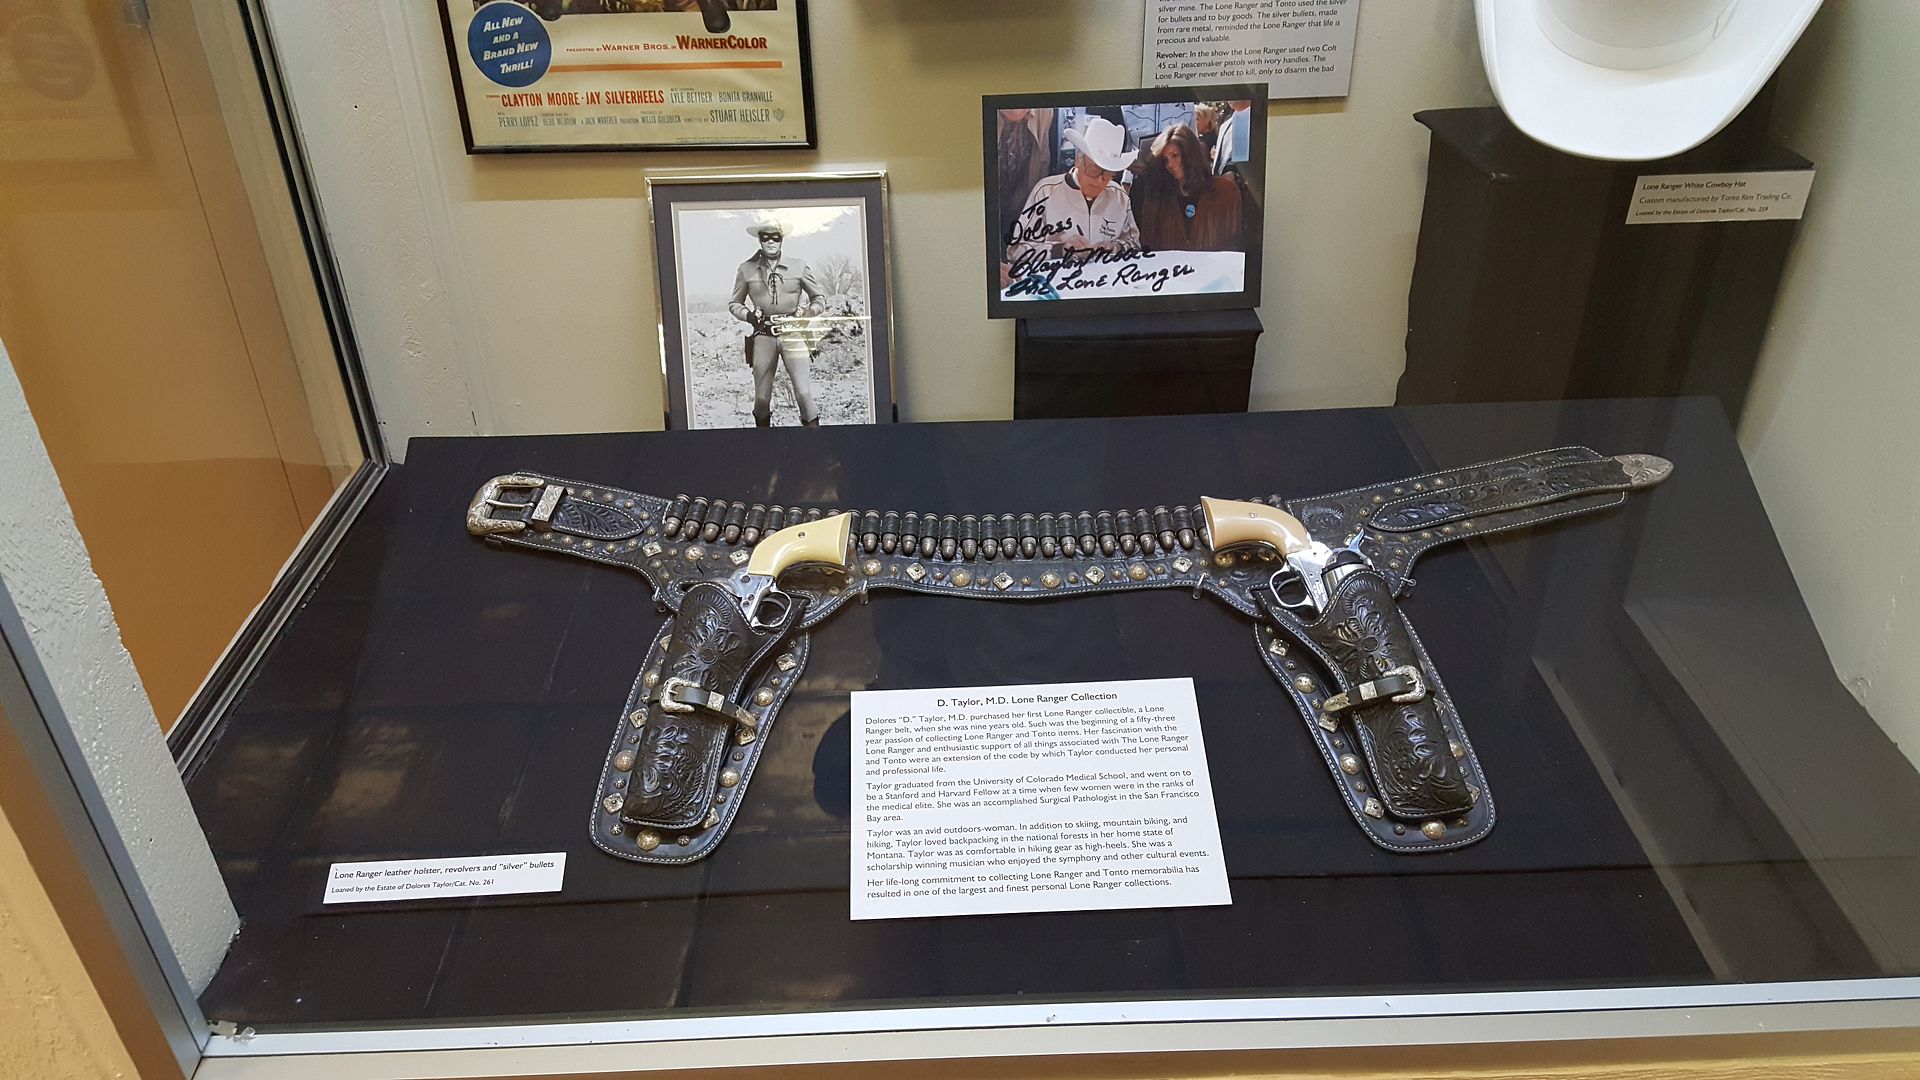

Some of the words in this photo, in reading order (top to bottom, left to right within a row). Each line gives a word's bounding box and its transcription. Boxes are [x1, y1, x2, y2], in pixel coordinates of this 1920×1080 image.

[483, 21, 500, 32] ALL
[502, 16, 523, 28] NEW
[1157, 26, 1175, 34] from
[1215, 22, 1249, 31] reminded
[1250, 22, 1262, 30] the
[1263, 21, 1281, 29] Lone
[1282, 20, 1307, 31] Ranger
[1308, 19, 1322, 27] that
[1322, 18, 1334, 26] life
[493, 34, 510, 44] AND
[676, 34, 768, 50] WARNERCOLOR
[1156, 36, 1186, 47] precious
[1187, 35, 1201, 43] and
[483, 48, 515, 60] BRAND
[516, 42, 539, 54] NEW
[1156, 50, 1188, 59] Revolver:
[1198, 49, 1210, 57] the
[1211, 48, 1230, 57] show
[1231, 48, 1243, 56] the
[1244, 47, 1262, 55] Lone
[1263, 46, 1287, 57] Ranger
[1288, 45, 1306, 53] used
[1306, 44, 1321, 52] two
[1322, 43, 1337, 51] Colt
[500, 59, 534, 74] THRILL!
[501, 92, 543, 107] CLAYTON
[547, 92, 580, 106] MOORE
[586, 91, 601, 105] JAY
[604, 90, 665, 105] SILVERHEELS
[670, 92, 684, 103] LYLE
[686, 91, 713, 103] BETTGER
[718, 91, 740, 102] BONITA
[742, 91, 773, 102] GRANVILLE
[499, 117, 518, 128] PERRY
[520, 116, 538, 127] LOPEZ
[710, 109, 737, 123] STUART
[740, 108, 770, 122] HEISLER
[1660, 182, 1683, 191] Ranger
[1706, 181, 1734, 189] Cowboy
[1022, 196, 1050, 218] To
[937, 698, 948, 707] D.
[950, 696, 983, 708] Taylor,
[986, 696, 1009, 705] M.D.
[1011, 695, 1035, 704] Lone
[1036, 693, 1069, 705] Ranger
[1070, 692, 1118, 702] Collection
[866, 746, 886, 755] Lone
[888, 745, 915, 756] Ranger
[917, 744, 932, 753] and
[933, 742, 979, 752] enthusiastic
[981, 741, 1012, 752] support
[1013, 740, 1022, 749] of
[1024, 740, 1033, 748] all
[1034, 739, 1058, 750] things
[1059, 737, 1100, 747] associated
[1101, 736, 1120, 745] with
[1120, 736, 1138, 744] The
[1139, 735, 1160, 744] Lone
[1161, 734, 1189, 745] Ranger
[866, 781, 892, 792] Taylor
[894, 779, 934, 791] graduated
[936, 778, 956, 787] from
[957, 777, 971, 786] the
[973, 776, 1014, 788] University
[1015, 775, 1024, 784] of
[1025, 774, 1064, 783] Colorado
[1066, 772, 1097, 781] Medical
[1098, 771, 1129, 782] School,
[1130, 770, 1145, 779] and
[1146, 769, 1168, 778] went
[1182, 768, 1192, 776] to
[866, 803, 880, 811] the
[881, 801, 913, 810] medical
[914, 800, 935, 809] elite.
[937, 800, 952, 808] She
[983, 796, 1038, 808] accomplished
[1039, 794, 1071, 806] Surgical
[1072, 792, 1118, 805] Pathologist
[1119, 792, 1127, 800] in
[1128, 791, 1143, 800] the
[1144, 791, 1159, 799] San
[1160, 789, 1200, 799] Francisco
[867, 861, 913, 873] scholarship
[915, 859, 947, 871] winning
[949, 858, 985, 867] musician
[987, 857, 1006, 866] who
[1007, 855, 1041, 867] enjoyed
[1042, 855, 1057, 863] the
[1058, 853, 1101, 865] symphony
[1103, 852, 1119, 861] and
[1120, 851, 1144, 860] other
[1146, 850, 1178, 859] cultural
[1179, 848, 1210, 858] events.
[335, 870, 354, 879] Lone
[356, 869, 382, 880] Ranger
[385, 867, 412, 877] leather
[413, 866, 443, 877] holster,
[445, 864, 480, 874] revolvers
[483, 863, 496, 872] and
[529, 860, 554, 869] bullets
[867, 878, 884, 887] Her
[886, 877, 919, 888] life-long
[921, 874, 975, 884] commitment
[977, 874, 987, 882] to
[988, 872, 1028, 884] collecting
[1030, 871, 1052, 880] Lone
[1053, 870, 1083, 881] Ranger
[1085, 869, 1101, 878] and
[1102, 868, 1129, 877] Tonto
[1131, 866, 1184, 876] memorabilia
[1185, 865, 1200, 874] has
[332, 886, 354, 894] Loaned
[355, 885, 363, 894] by
[406, 881, 430, 890] Dolores
